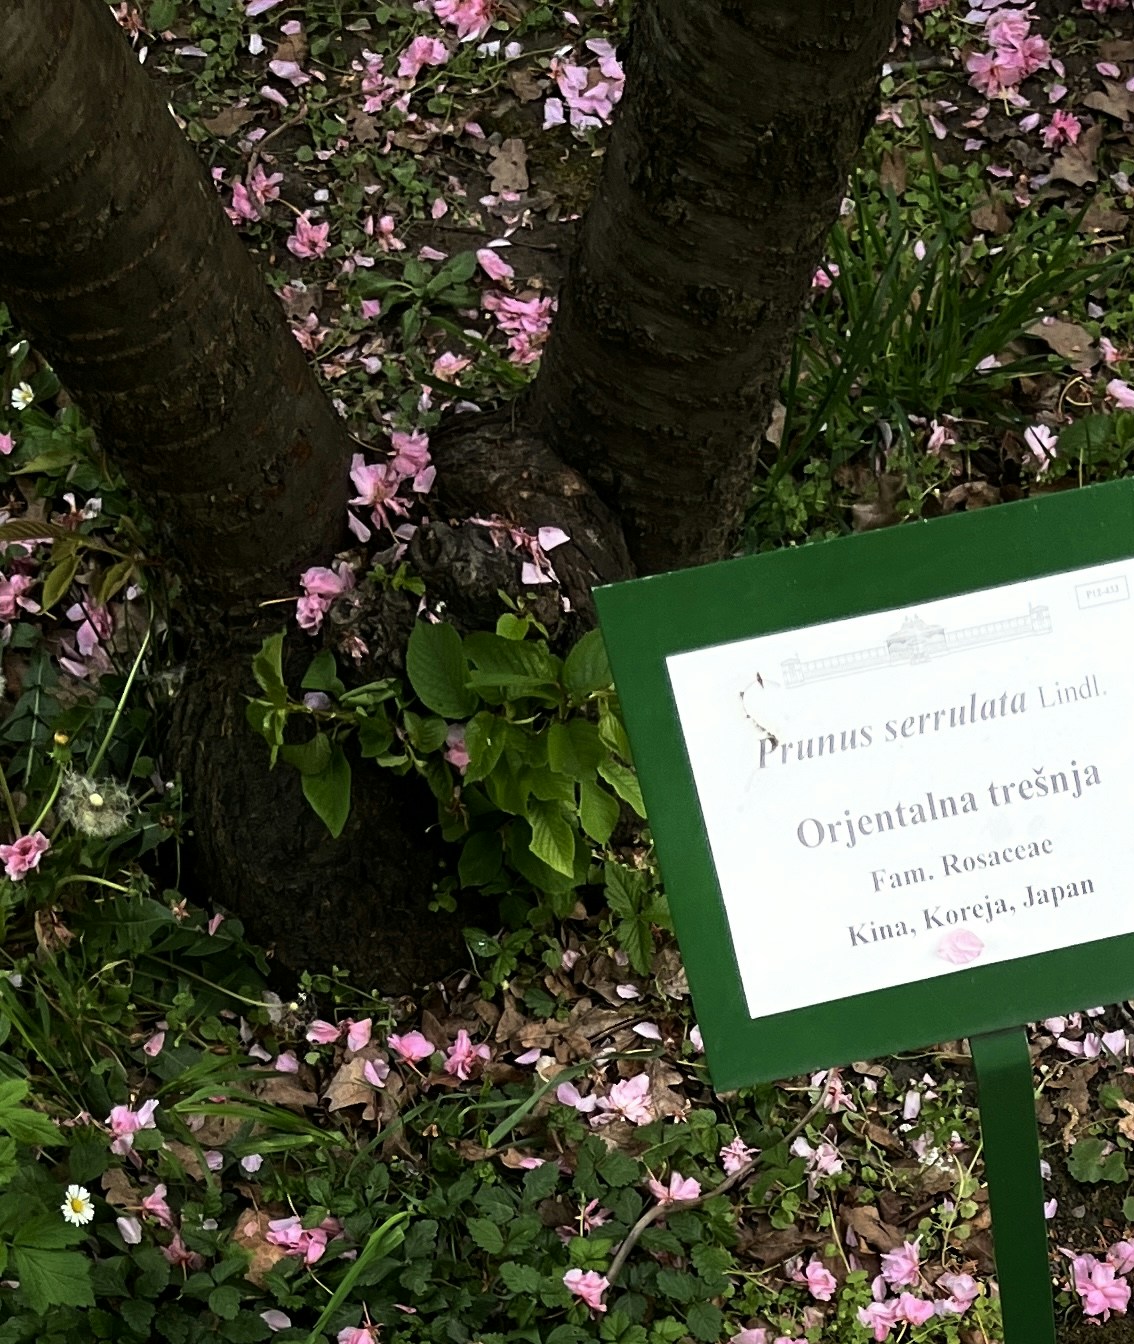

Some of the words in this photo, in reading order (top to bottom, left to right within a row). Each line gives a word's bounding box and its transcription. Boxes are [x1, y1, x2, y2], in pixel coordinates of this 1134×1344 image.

[758, 725, 873, 769] Prunus
[883, 692, 1027, 742] serrulata
[1038, 674, 1107, 709] Lindl.
[796, 791, 978, 849] Orjentalna
[988, 760, 1102, 809] trešnja
[871, 868, 934, 893] Fam.
[942, 837, 1054, 877] Rosaceae
[847, 921, 917, 948] Kina,
[922, 895, 1016, 932] Koreja,
[1023, 878, 1096, 908] Japan
